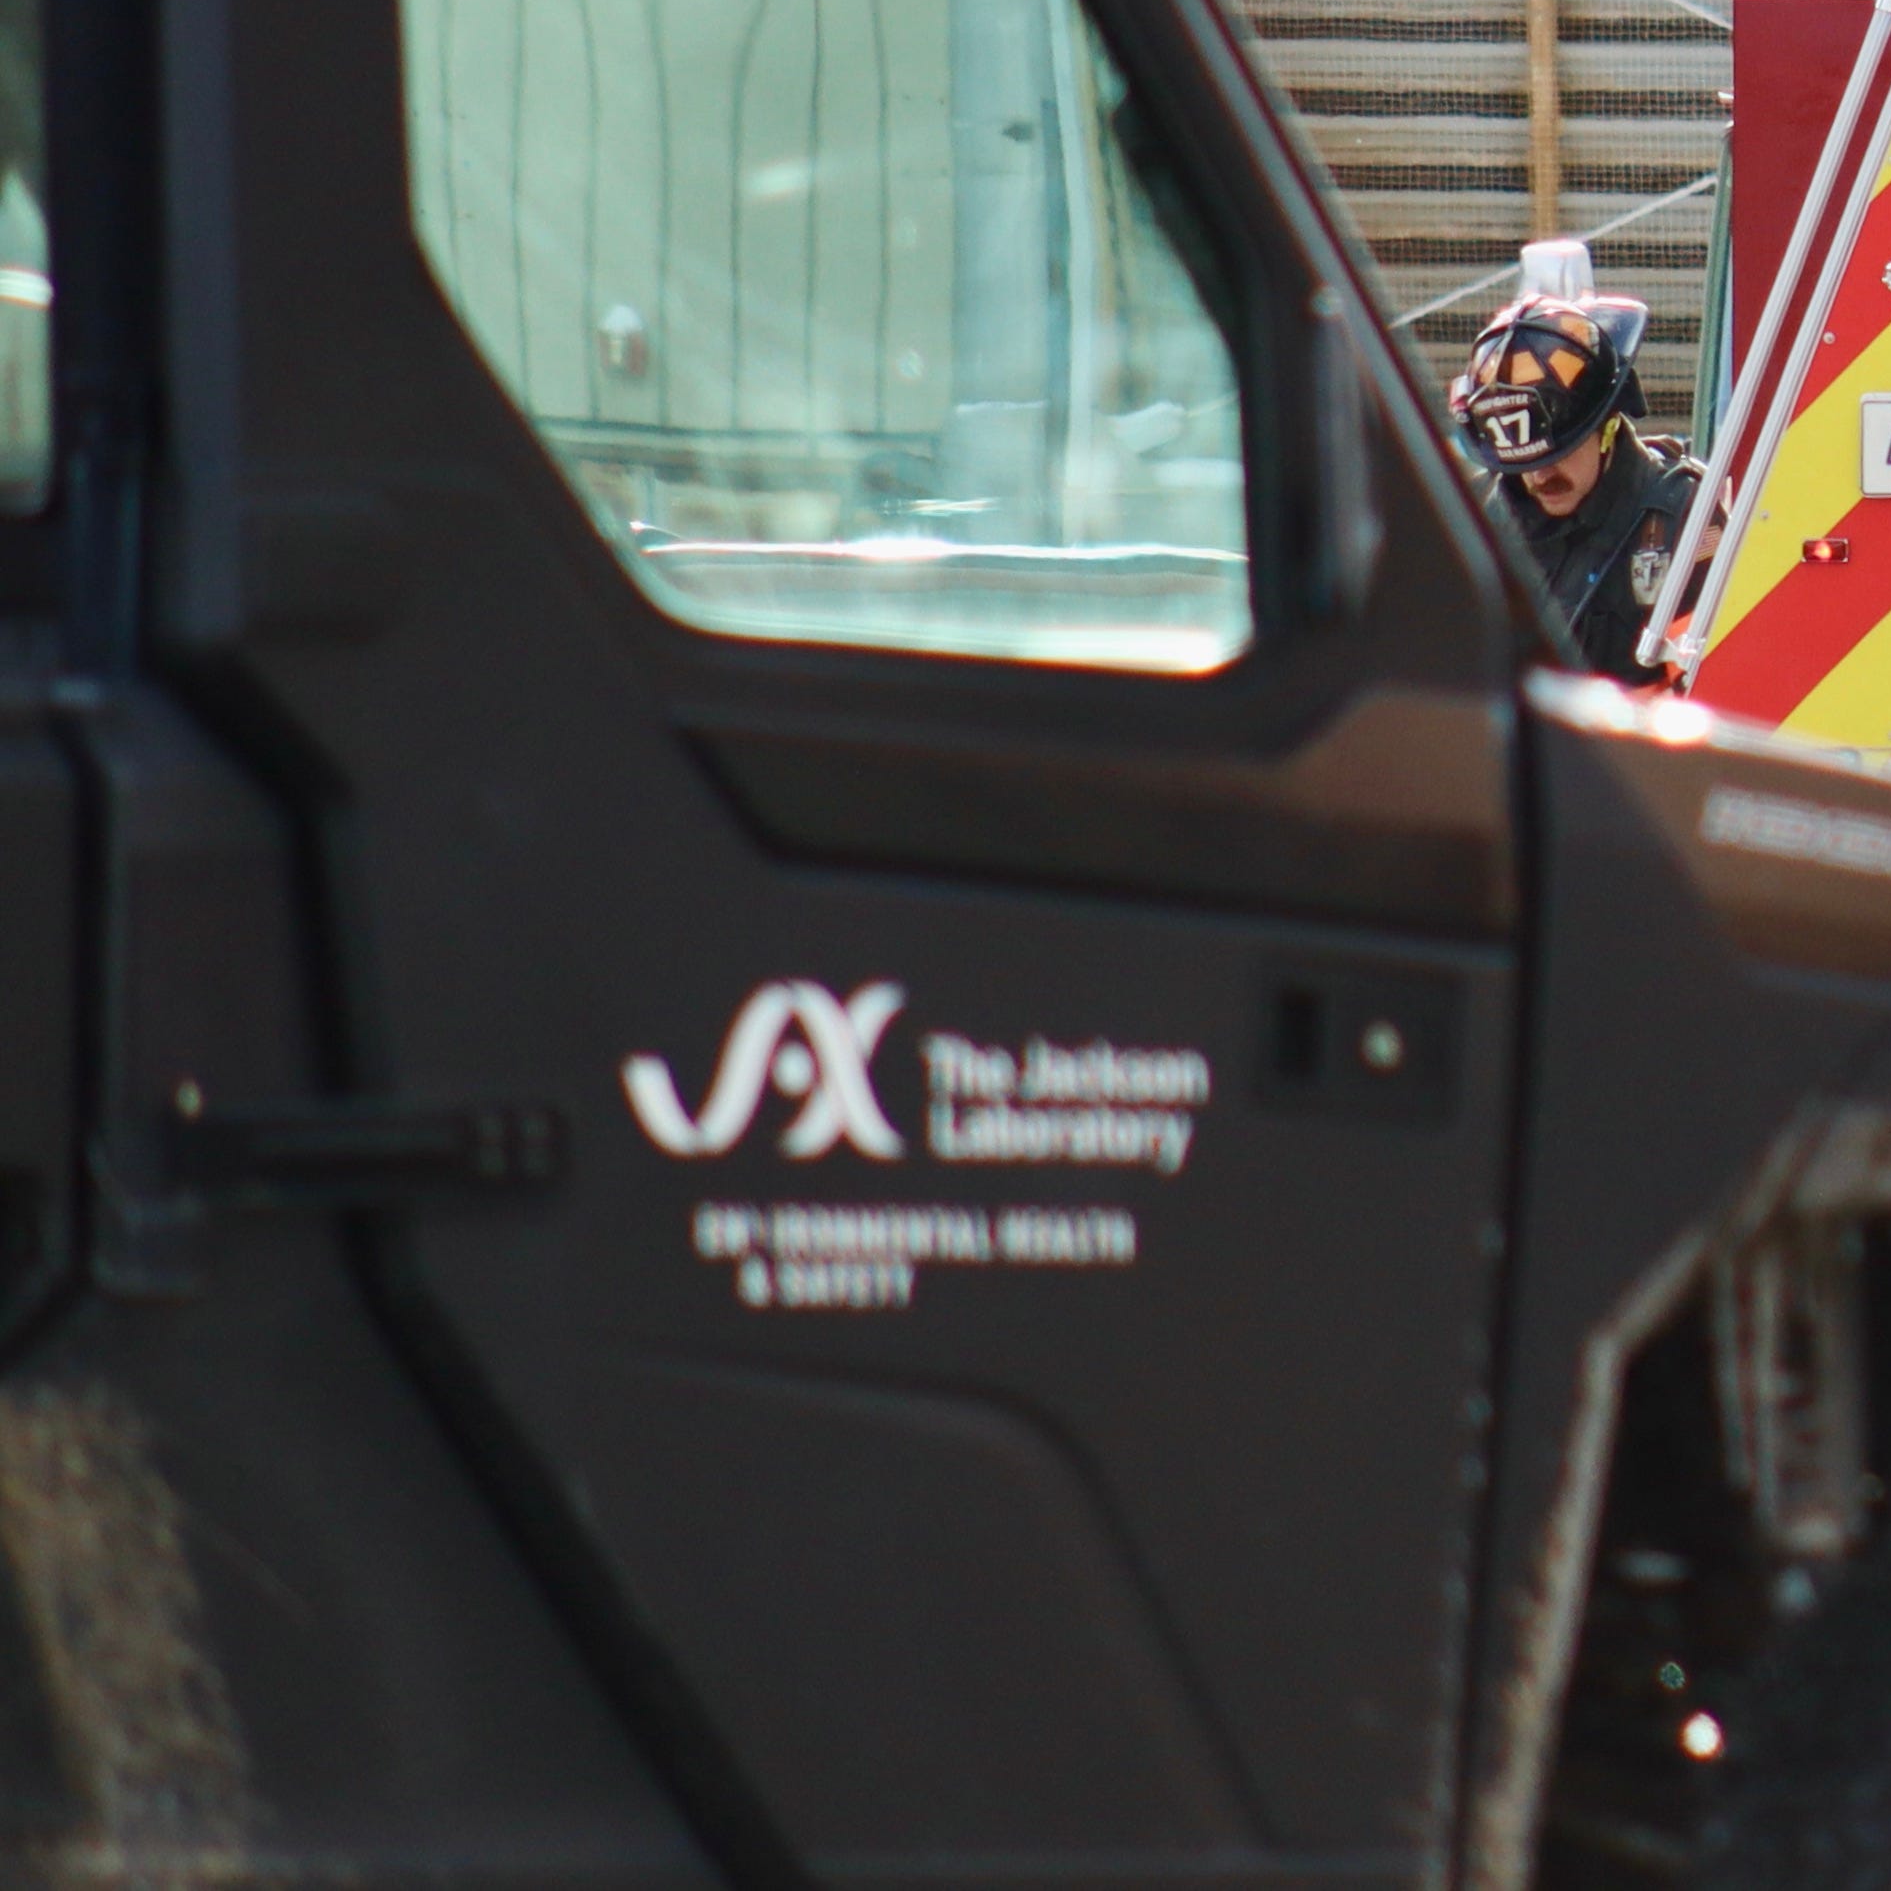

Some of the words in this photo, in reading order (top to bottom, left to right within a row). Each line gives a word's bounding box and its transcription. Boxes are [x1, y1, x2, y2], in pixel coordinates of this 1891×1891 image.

[1485, 408, 1530, 448] 17
[924, 1032, 1016, 1098] The
[1019, 1034, 1209, 1103] Jackson
[927, 1101, 1193, 1175] Laboratory
